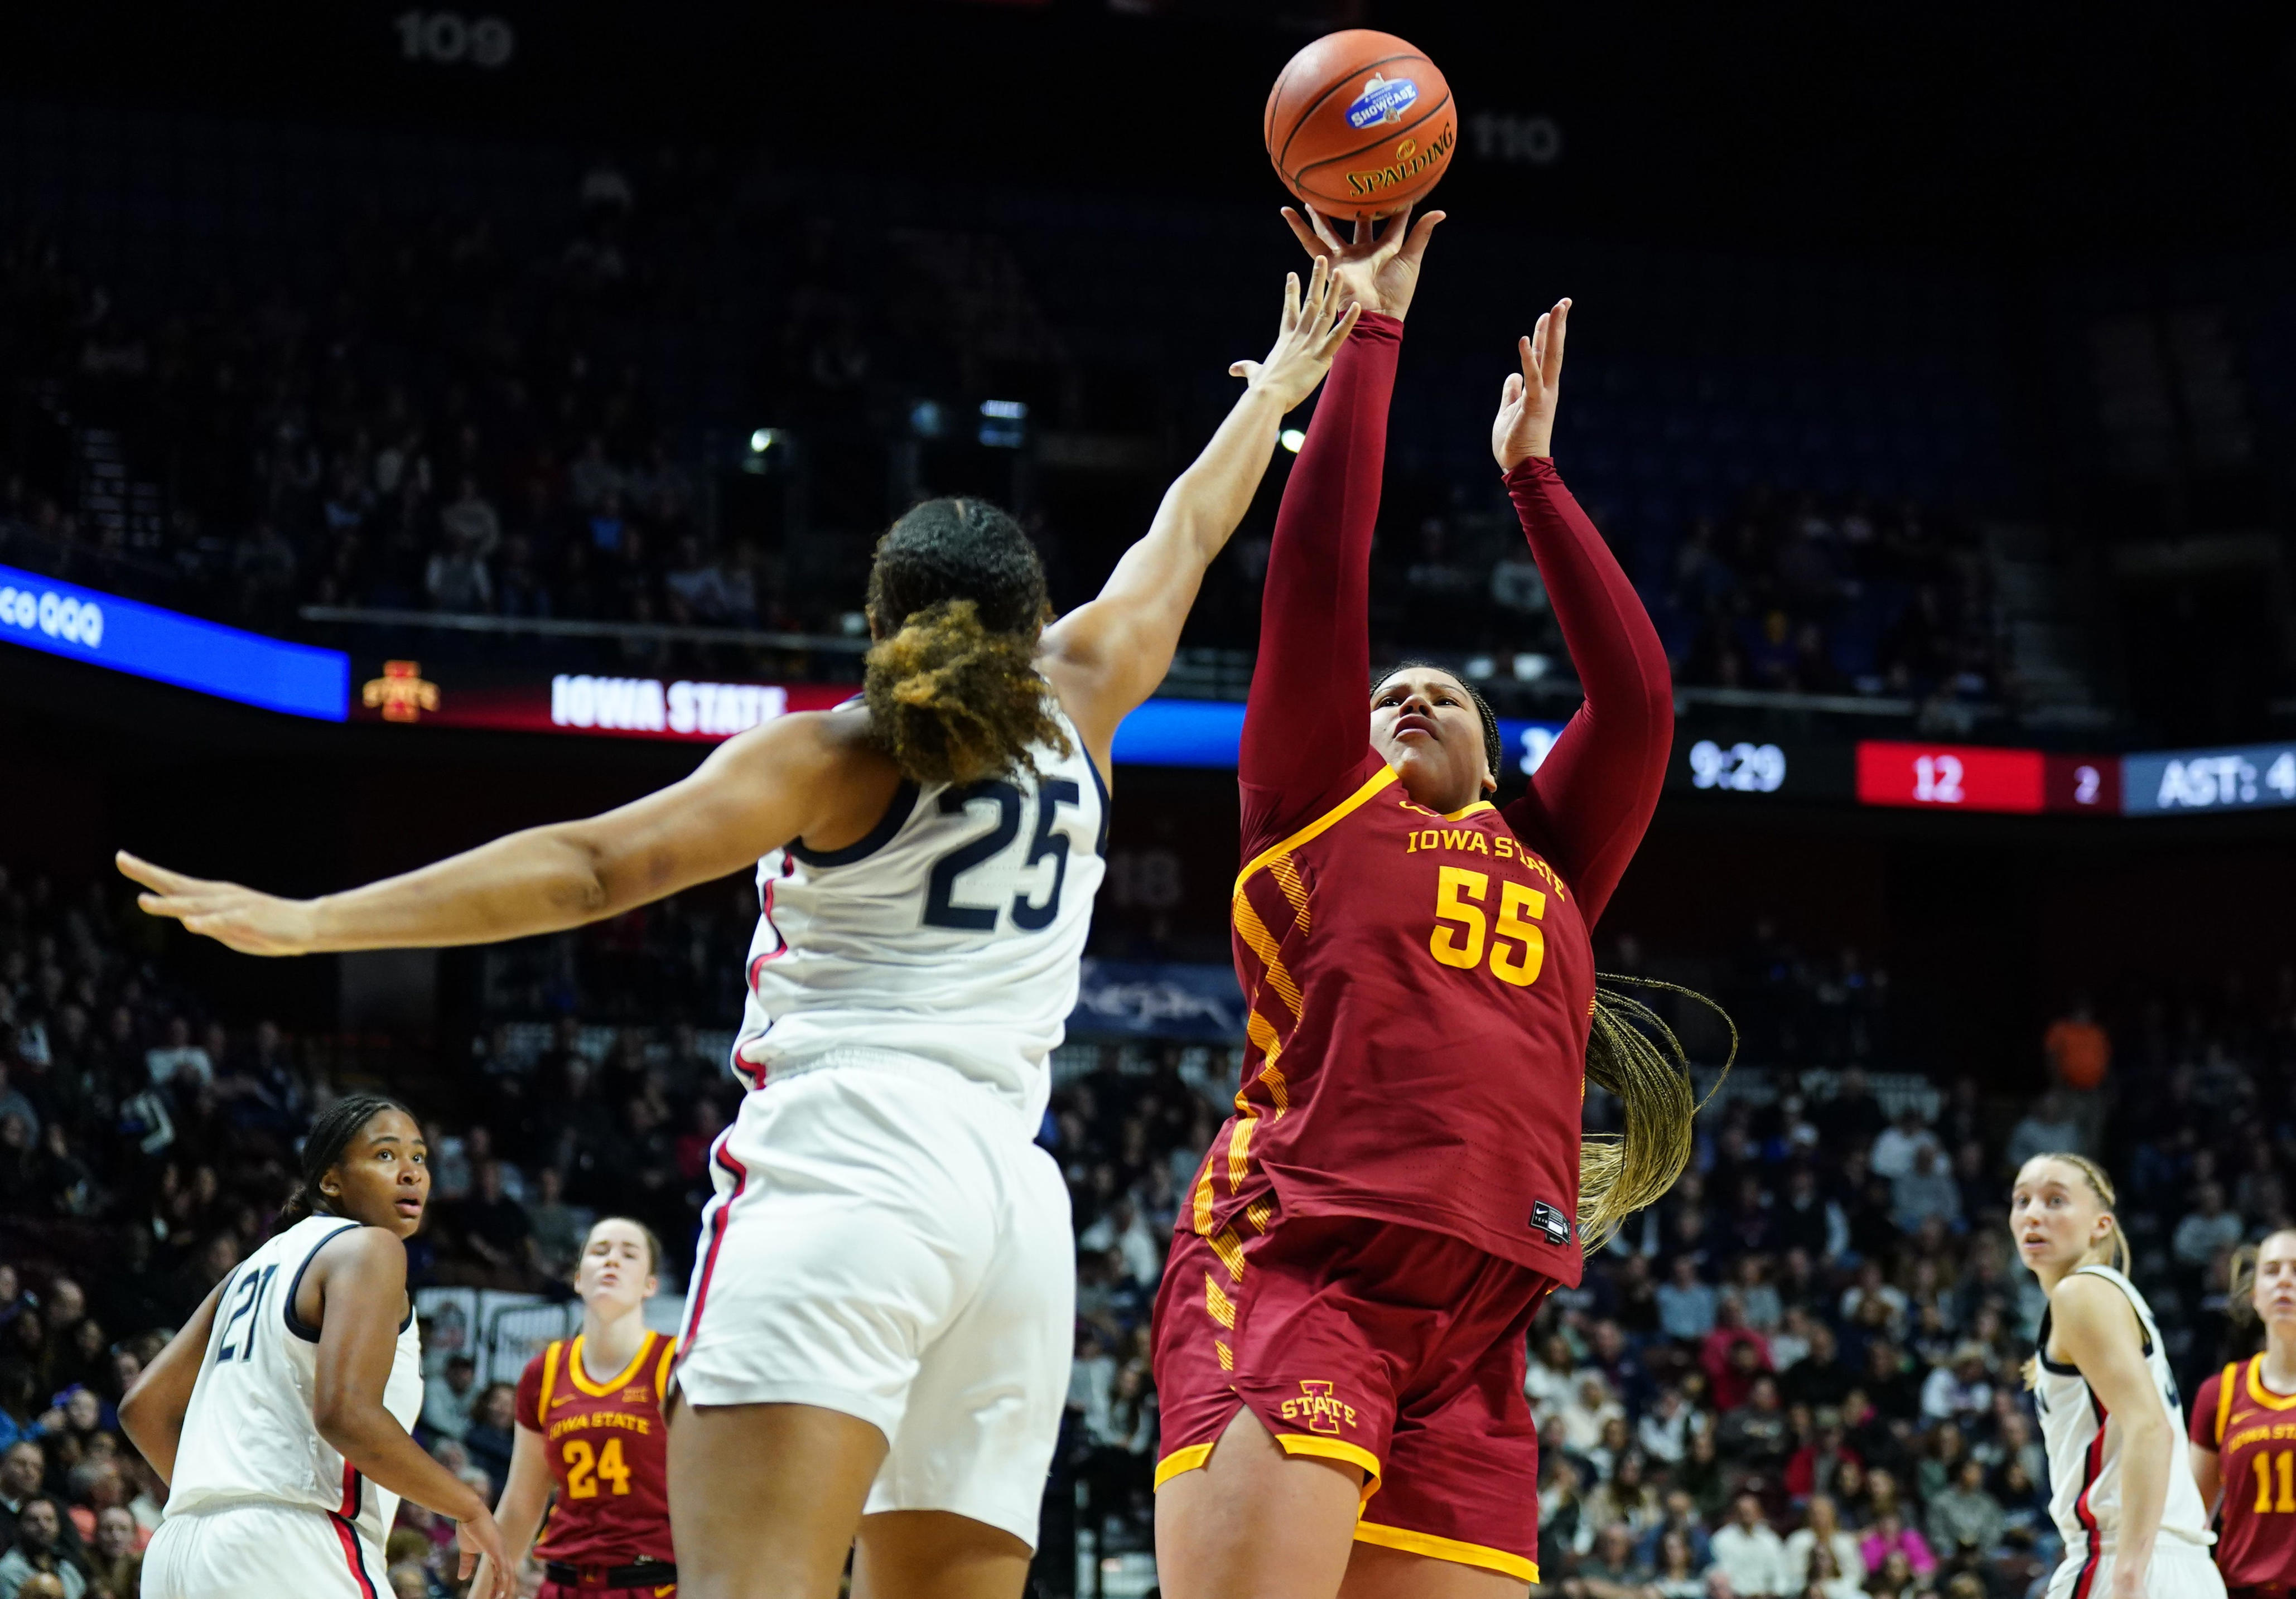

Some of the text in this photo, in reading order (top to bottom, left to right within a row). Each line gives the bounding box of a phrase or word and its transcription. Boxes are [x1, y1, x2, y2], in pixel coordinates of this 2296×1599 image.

[393, 7, 515, 68] 109
[1351, 84, 1416, 127] SHOWCASE
[1347, 122, 1454, 197] SPALDING
[1468, 112, 1560, 165] 110
[551, 674, 787, 735] IOWA STATE
[1689, 740, 1784, 792] 9:29
[1913, 755, 1964, 803] 12
[2074, 766, 2100, 804] 2
[2157, 756, 2258, 808] AST:
[920, 778, 1080, 933] 25
[1407, 829, 1565, 902] IOWA STATE
[1430, 866, 1546, 987] 55
[216, 1263, 279, 1363] 21
[549, 1411, 651, 1441] IOWA STATE
[1281, 1396, 1357, 1428] STATE
[562, 1437, 631, 1500] 24
[2252, 1451, 2296, 1514] 11
